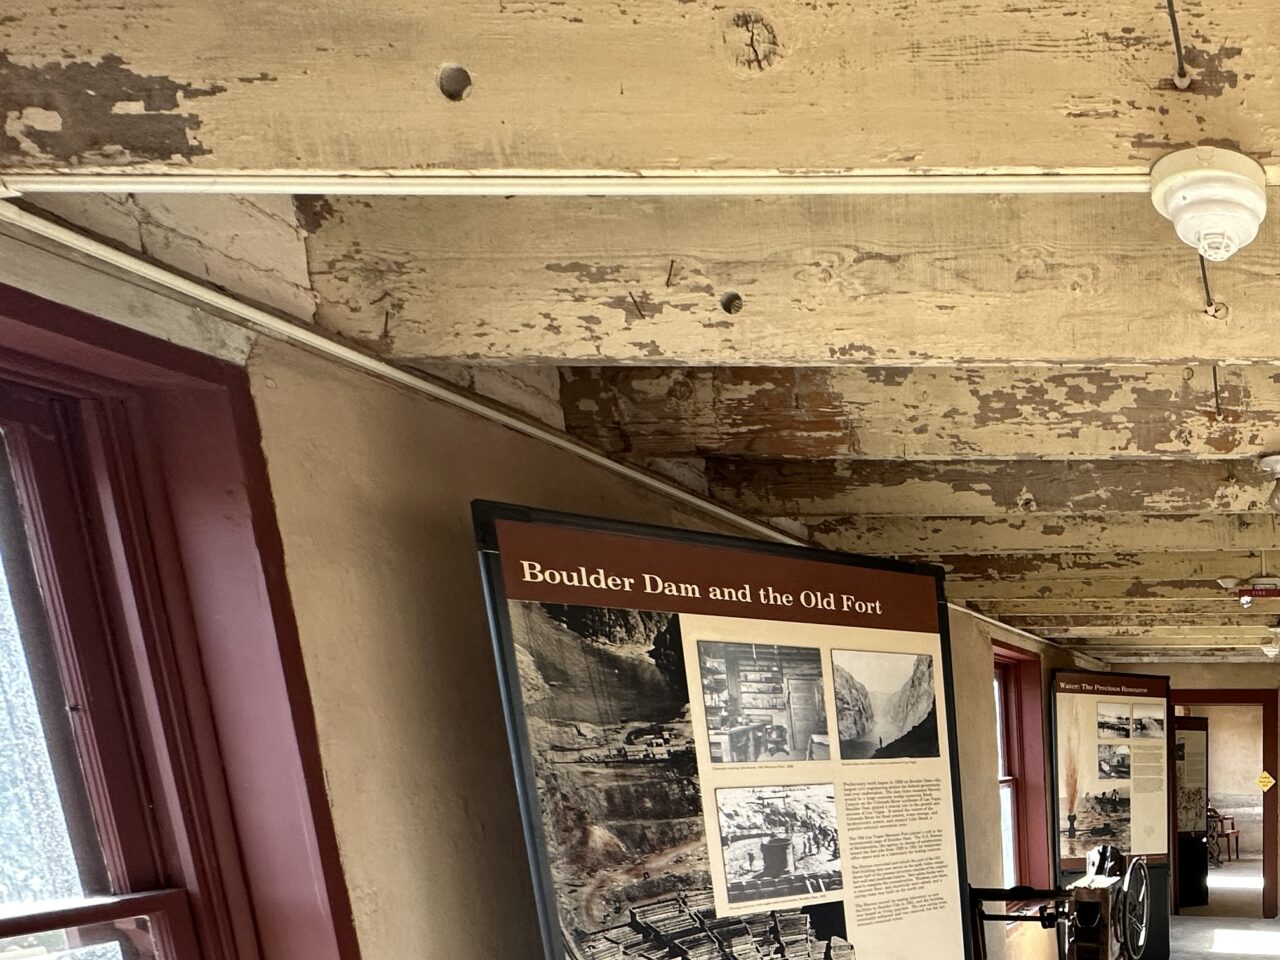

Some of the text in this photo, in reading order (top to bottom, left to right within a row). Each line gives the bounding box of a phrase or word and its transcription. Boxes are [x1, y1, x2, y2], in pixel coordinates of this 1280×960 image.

[519, 560, 883, 615] Boulder Dam and the Old Fort
[1081, 683, 1094, 691] The
[1094, 684, 1120, 692] Precious
